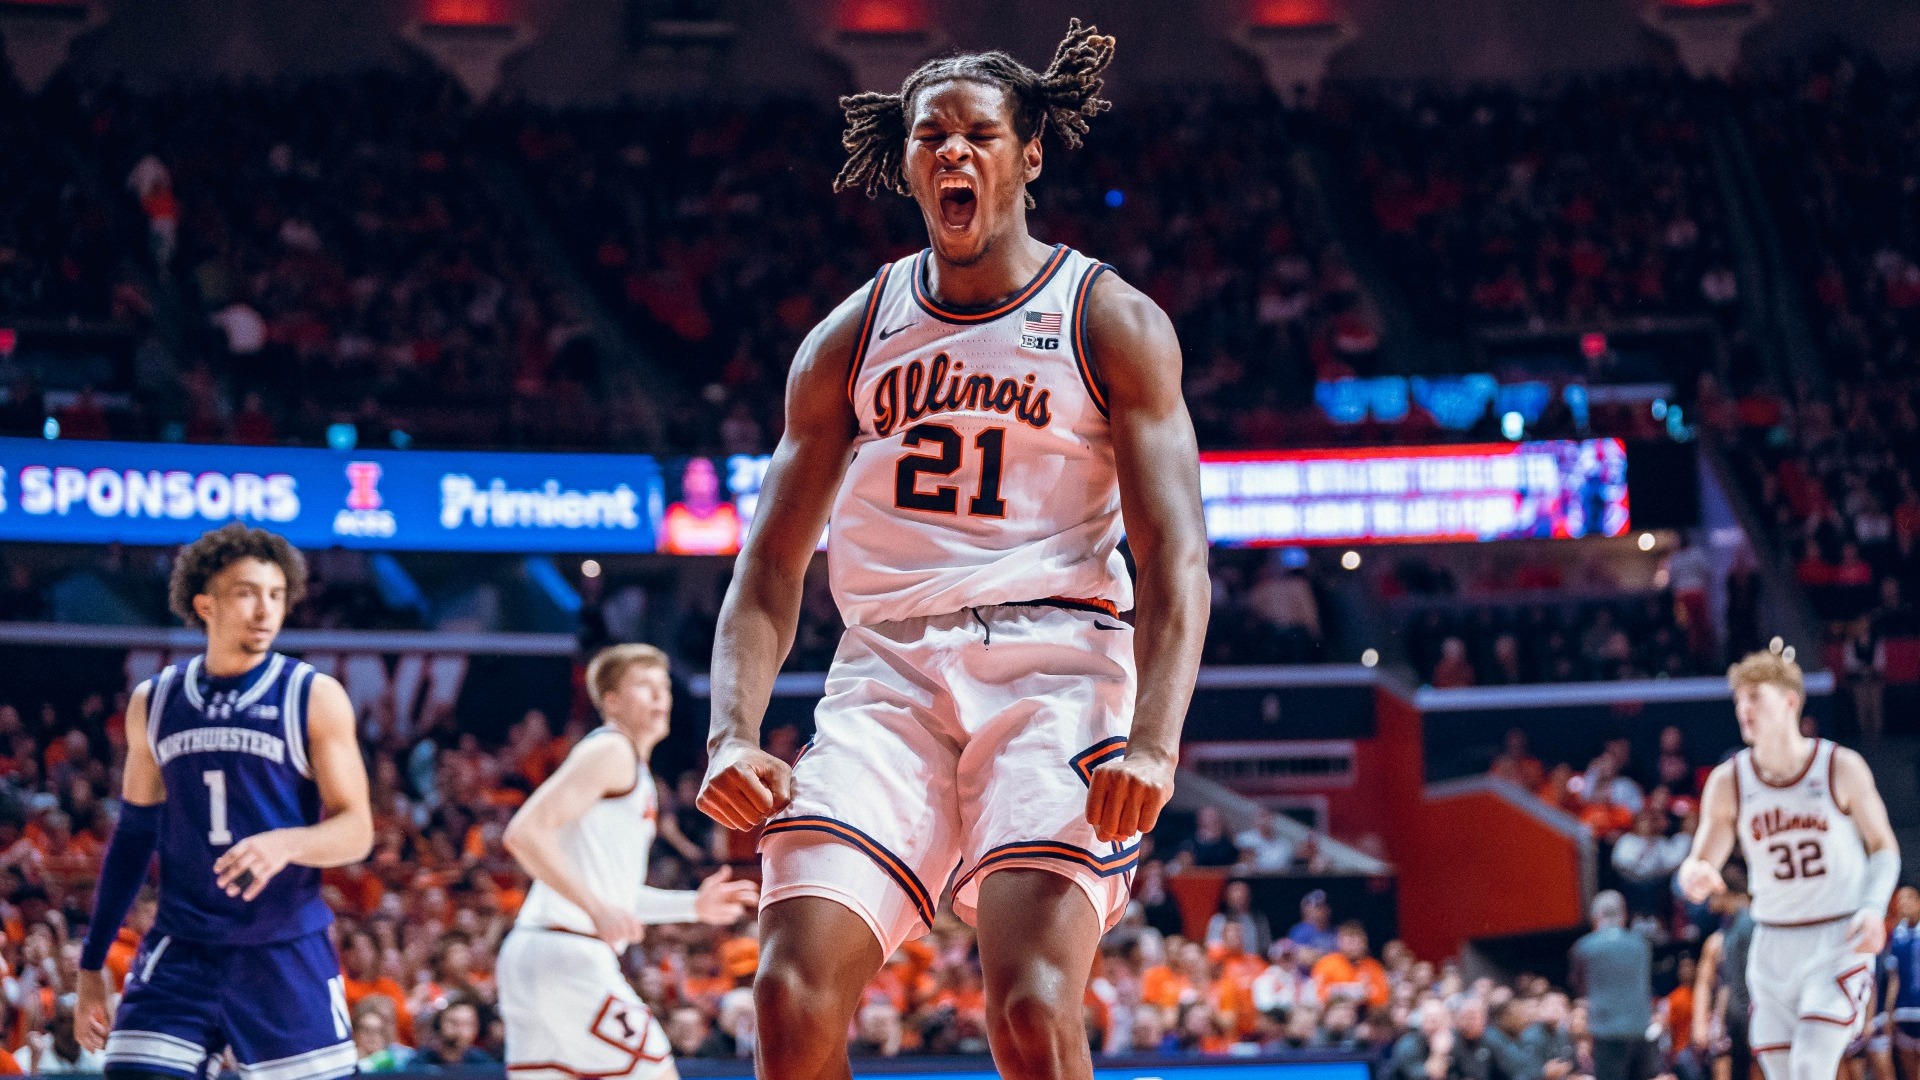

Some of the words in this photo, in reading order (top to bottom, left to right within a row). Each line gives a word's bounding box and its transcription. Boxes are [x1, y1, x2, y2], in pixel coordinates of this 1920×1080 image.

[873, 352, 1052, 438] Illinois
[20, 465, 300, 522] SPONSORS
[894, 423, 1007, 519] 21
[440, 474, 640, 528] Primient
[157, 727, 285, 765] NORTHWESTERN
[203, 769, 233, 846] 1
[1768, 841, 1826, 880] 32
